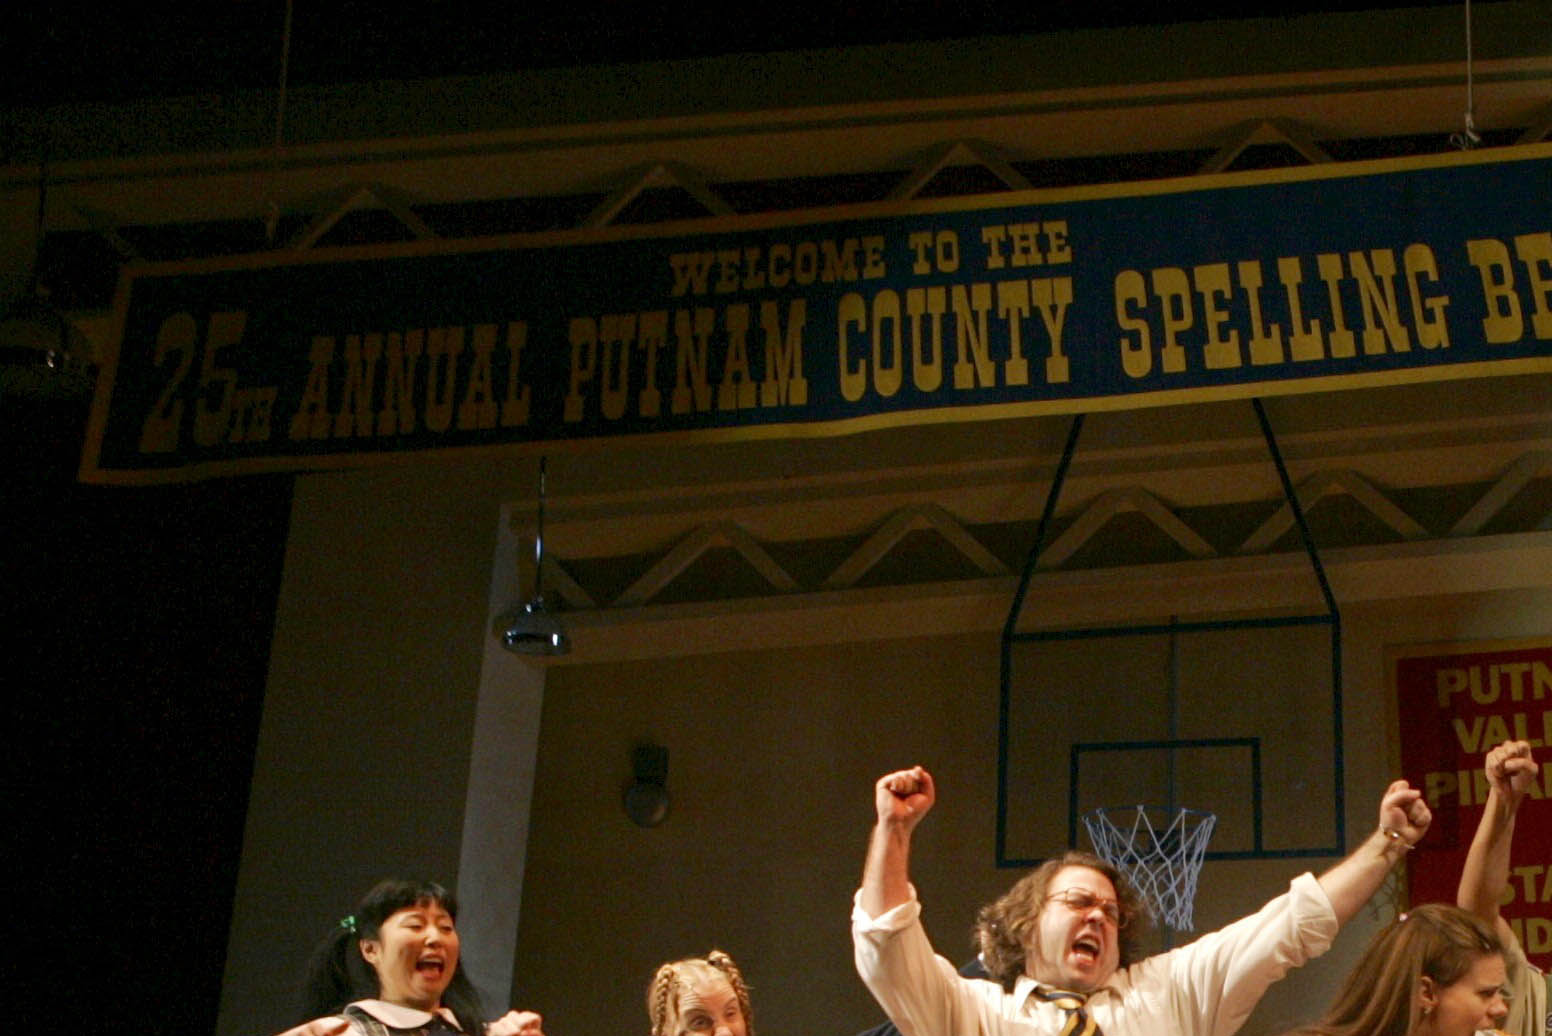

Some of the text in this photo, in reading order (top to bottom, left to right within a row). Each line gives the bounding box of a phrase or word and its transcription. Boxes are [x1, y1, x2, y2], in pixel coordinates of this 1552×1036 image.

[669, 221, 1074, 297] WELCOME TO THE
[137, 312, 279, 454] 25TH
[288, 319, 532, 441] ANNUAL
[563, 299, 809, 424] PUTNAM
[837, 277, 1075, 403] COUNTY
[1114, 242, 1450, 380] SPELLING
